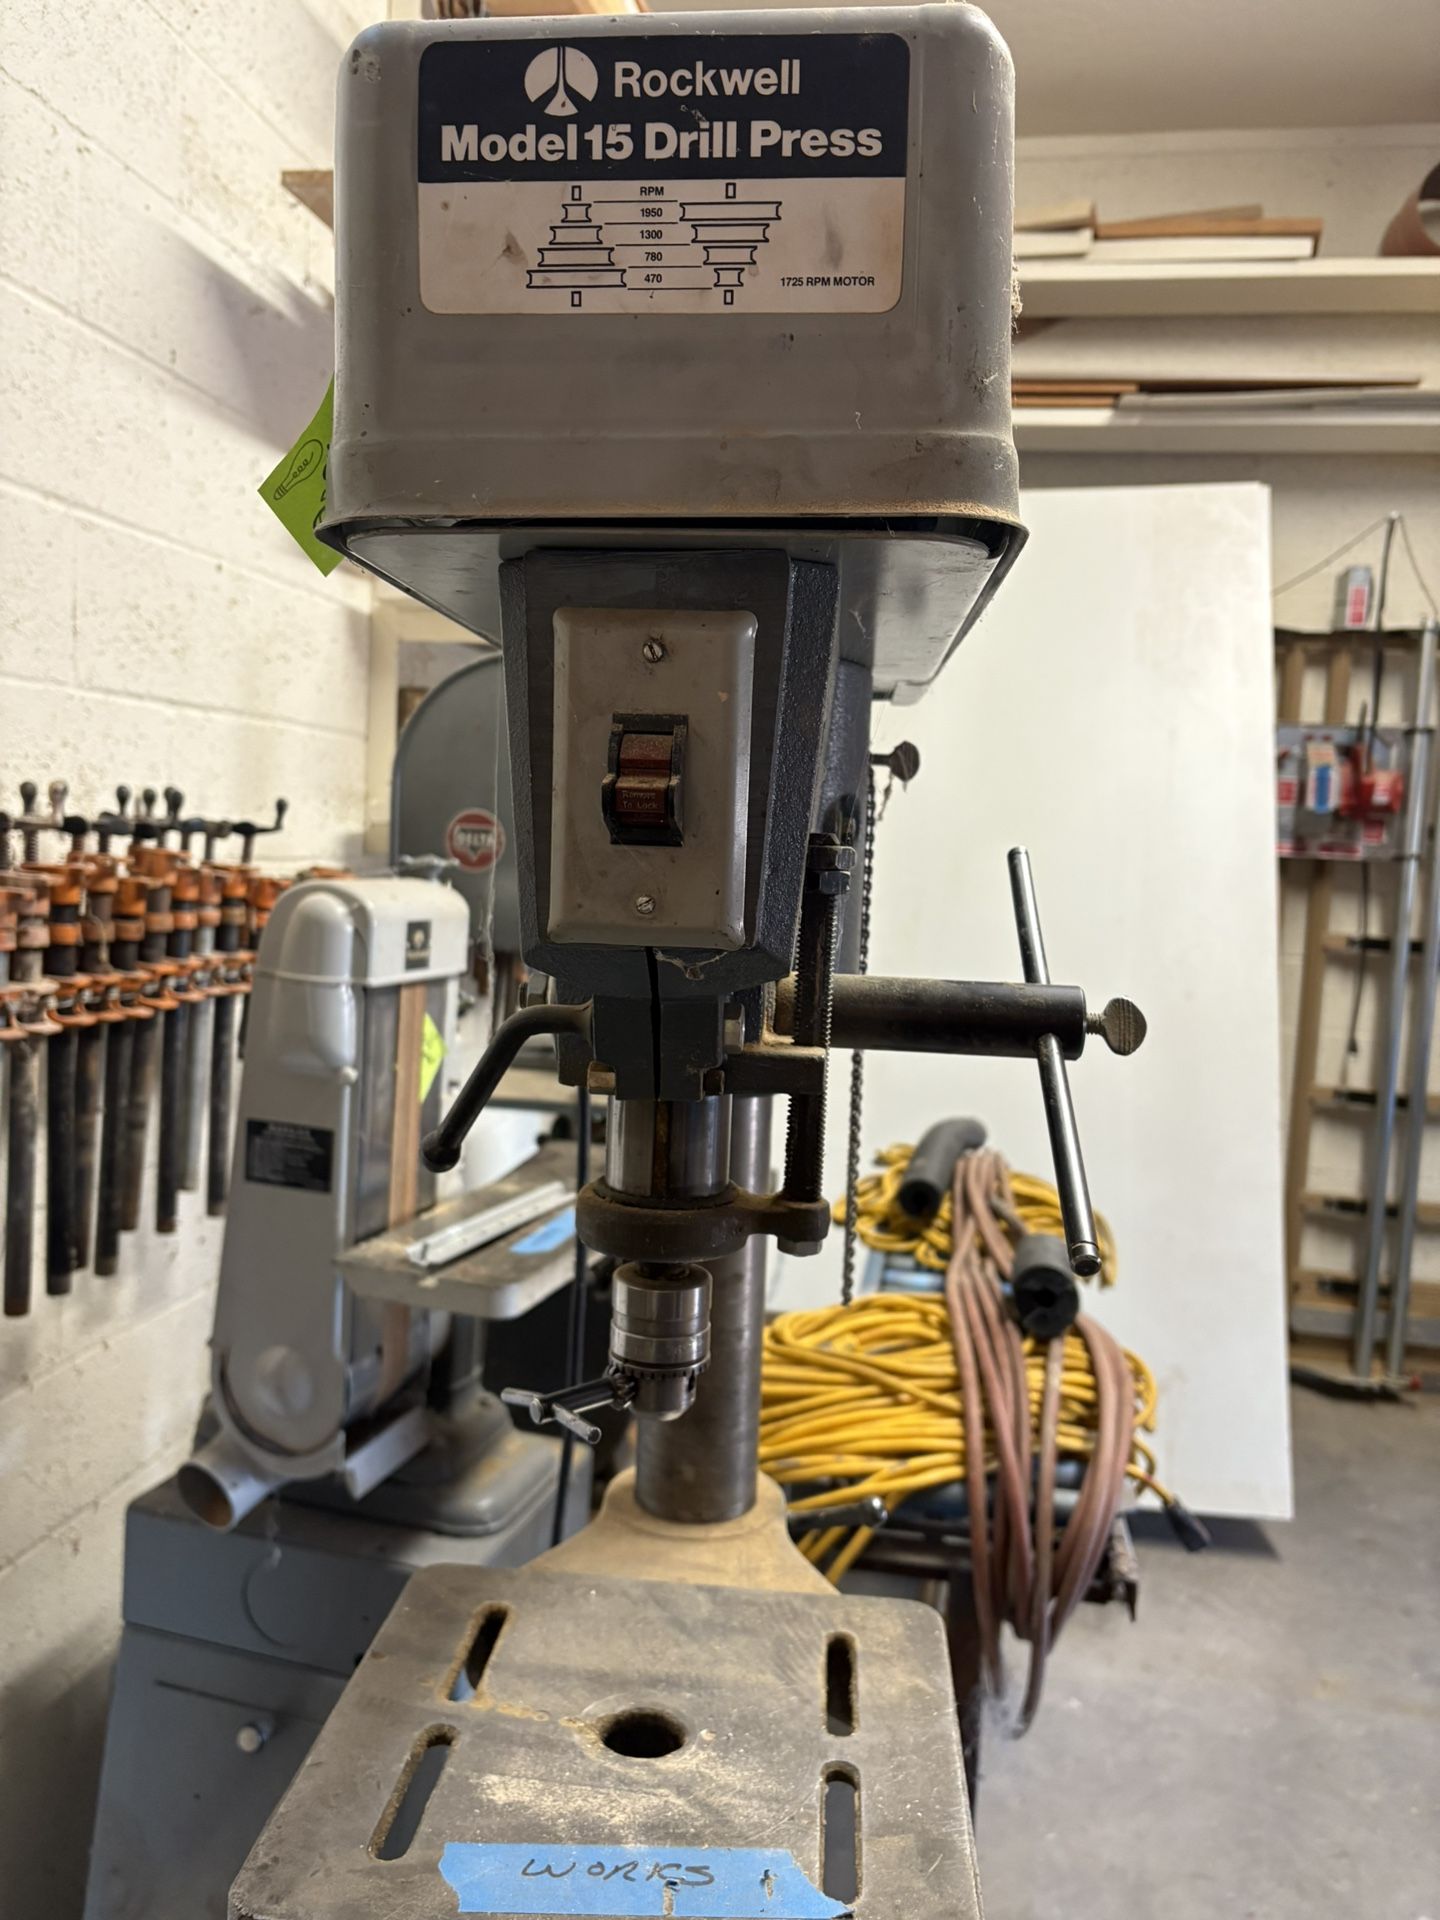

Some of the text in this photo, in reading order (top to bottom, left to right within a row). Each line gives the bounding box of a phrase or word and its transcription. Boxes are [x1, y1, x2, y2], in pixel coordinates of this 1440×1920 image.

[614, 59, 801, 97] Rockwell
[441, 120, 883, 162] Model 15 Drill Press
[640, 186, 665, 196] RPM
[640, 208, 663, 218] 1950
[640, 230, 663, 240] 1300
[644, 252, 663, 262] 780
[644, 273, 663, 284] 470
[781, 276, 875, 287] 1725 RPM MOTOR
